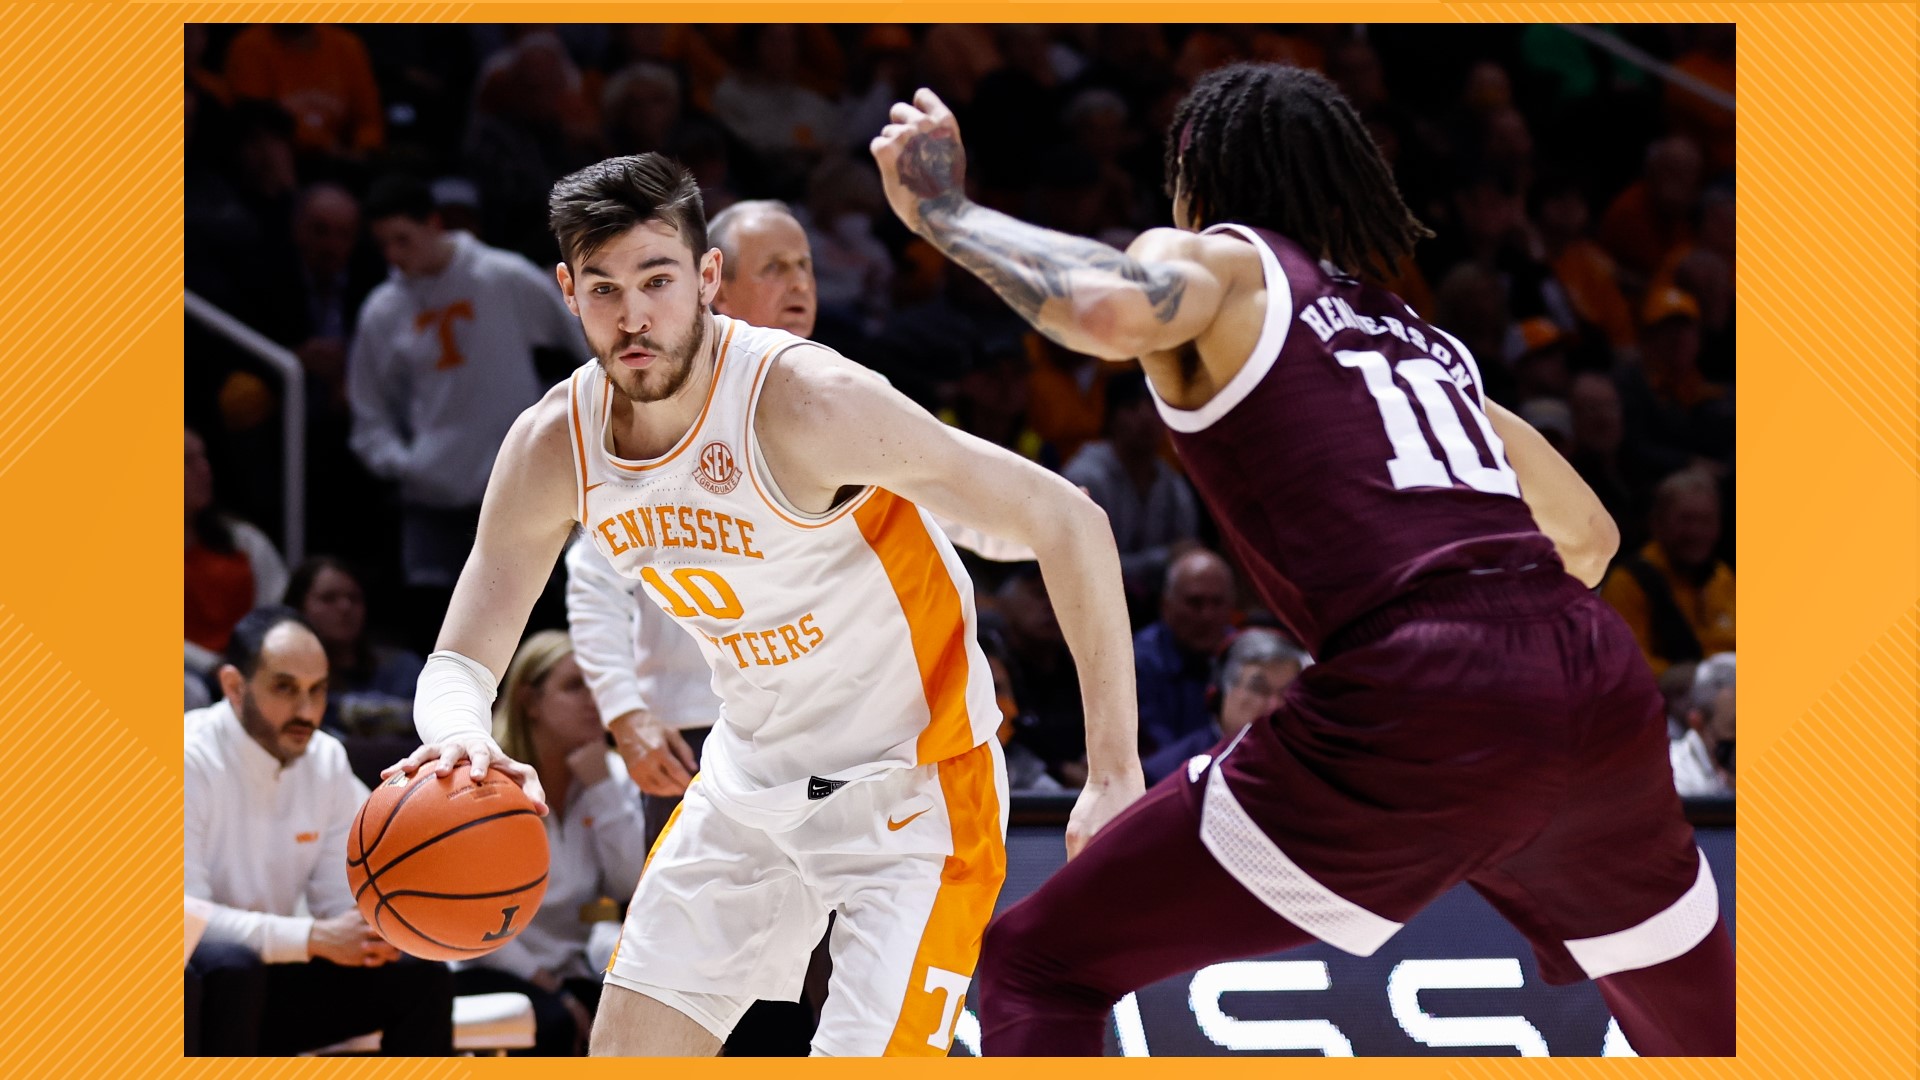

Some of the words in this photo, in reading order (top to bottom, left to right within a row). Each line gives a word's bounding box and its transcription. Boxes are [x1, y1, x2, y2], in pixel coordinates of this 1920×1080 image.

[414, 300, 476, 371] T
[1299, 296, 1473, 390] HENERSON
[1334, 349, 1521, 498] 10
[699, 477, 737, 493] GRADUATE
[702, 444, 733, 481] SEC
[593, 505, 765, 560] ENNESSEE
[640, 566, 745, 620] 10
[697, 612, 824, 669] TEERS
[923, 965, 972, 1049] T
